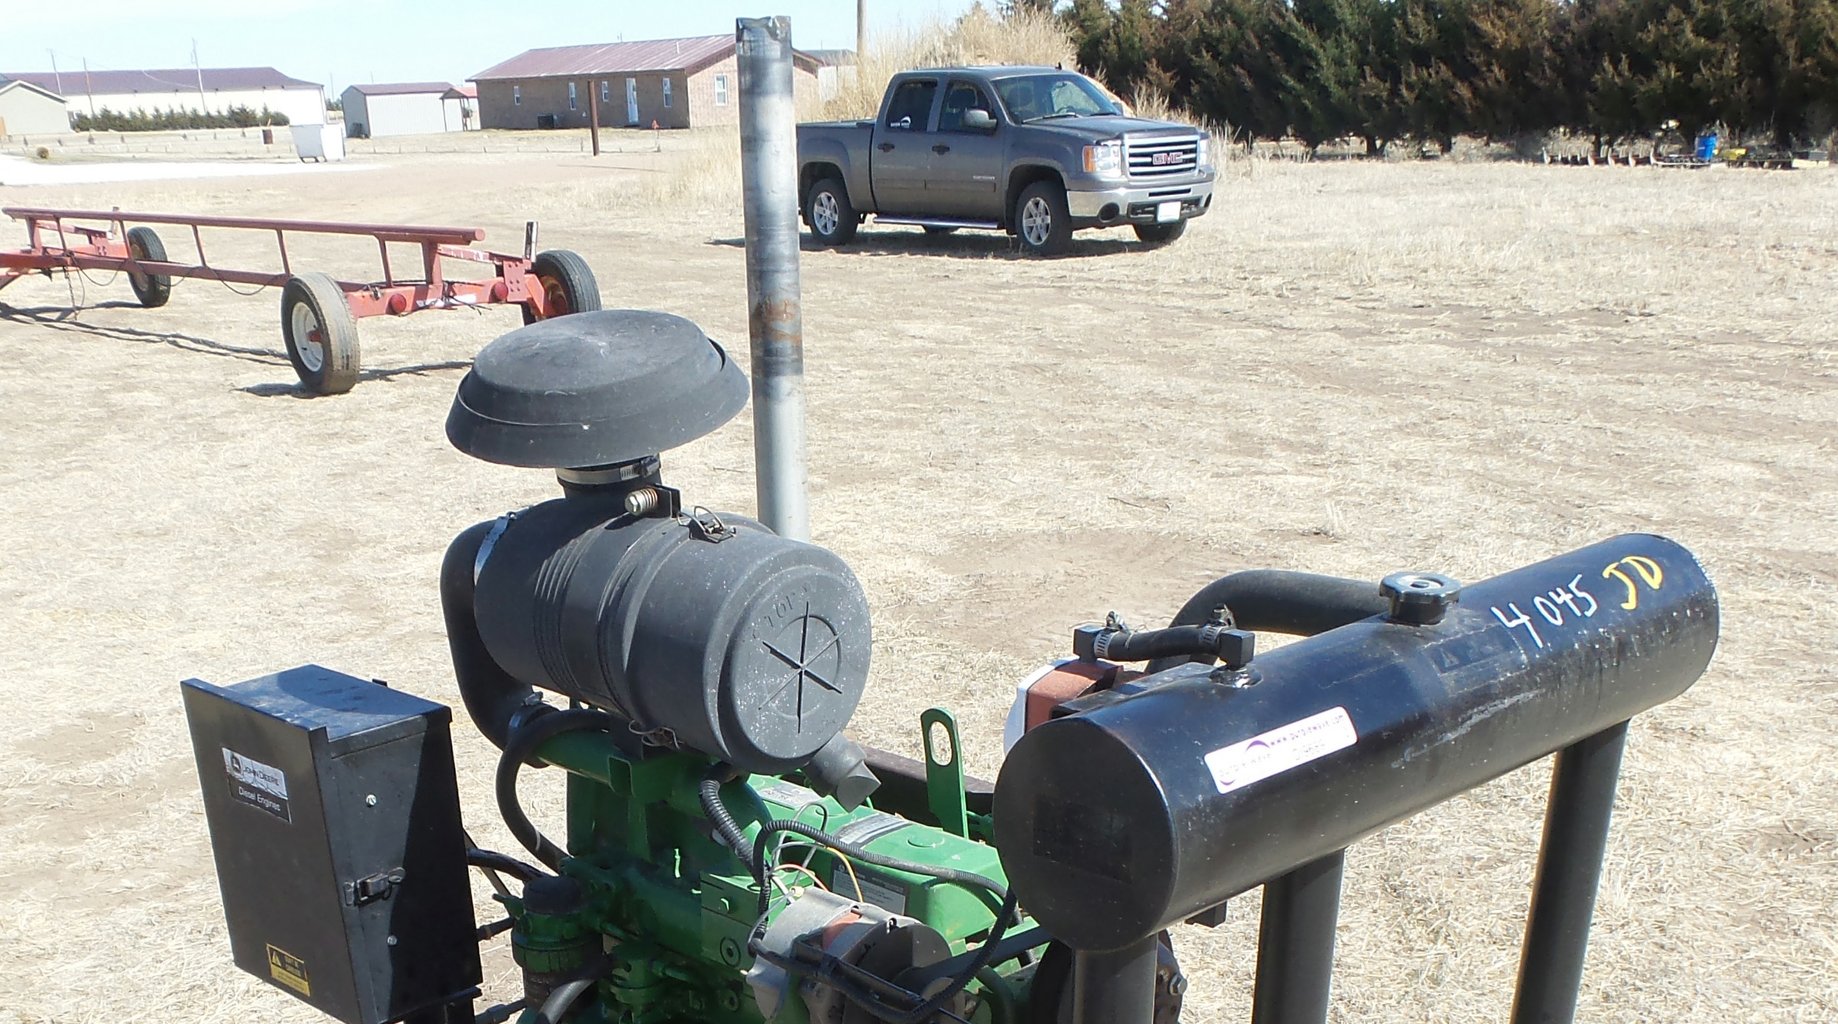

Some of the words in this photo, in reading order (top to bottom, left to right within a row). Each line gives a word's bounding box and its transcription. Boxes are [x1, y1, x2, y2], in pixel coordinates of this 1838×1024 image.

[1153, 152, 1183, 165] GMC
[1602, 555, 1663, 610] JD
[258, 770, 279, 786] DEERE
[238, 786, 256, 800] Diesel
[256, 793, 281, 811] Engines
